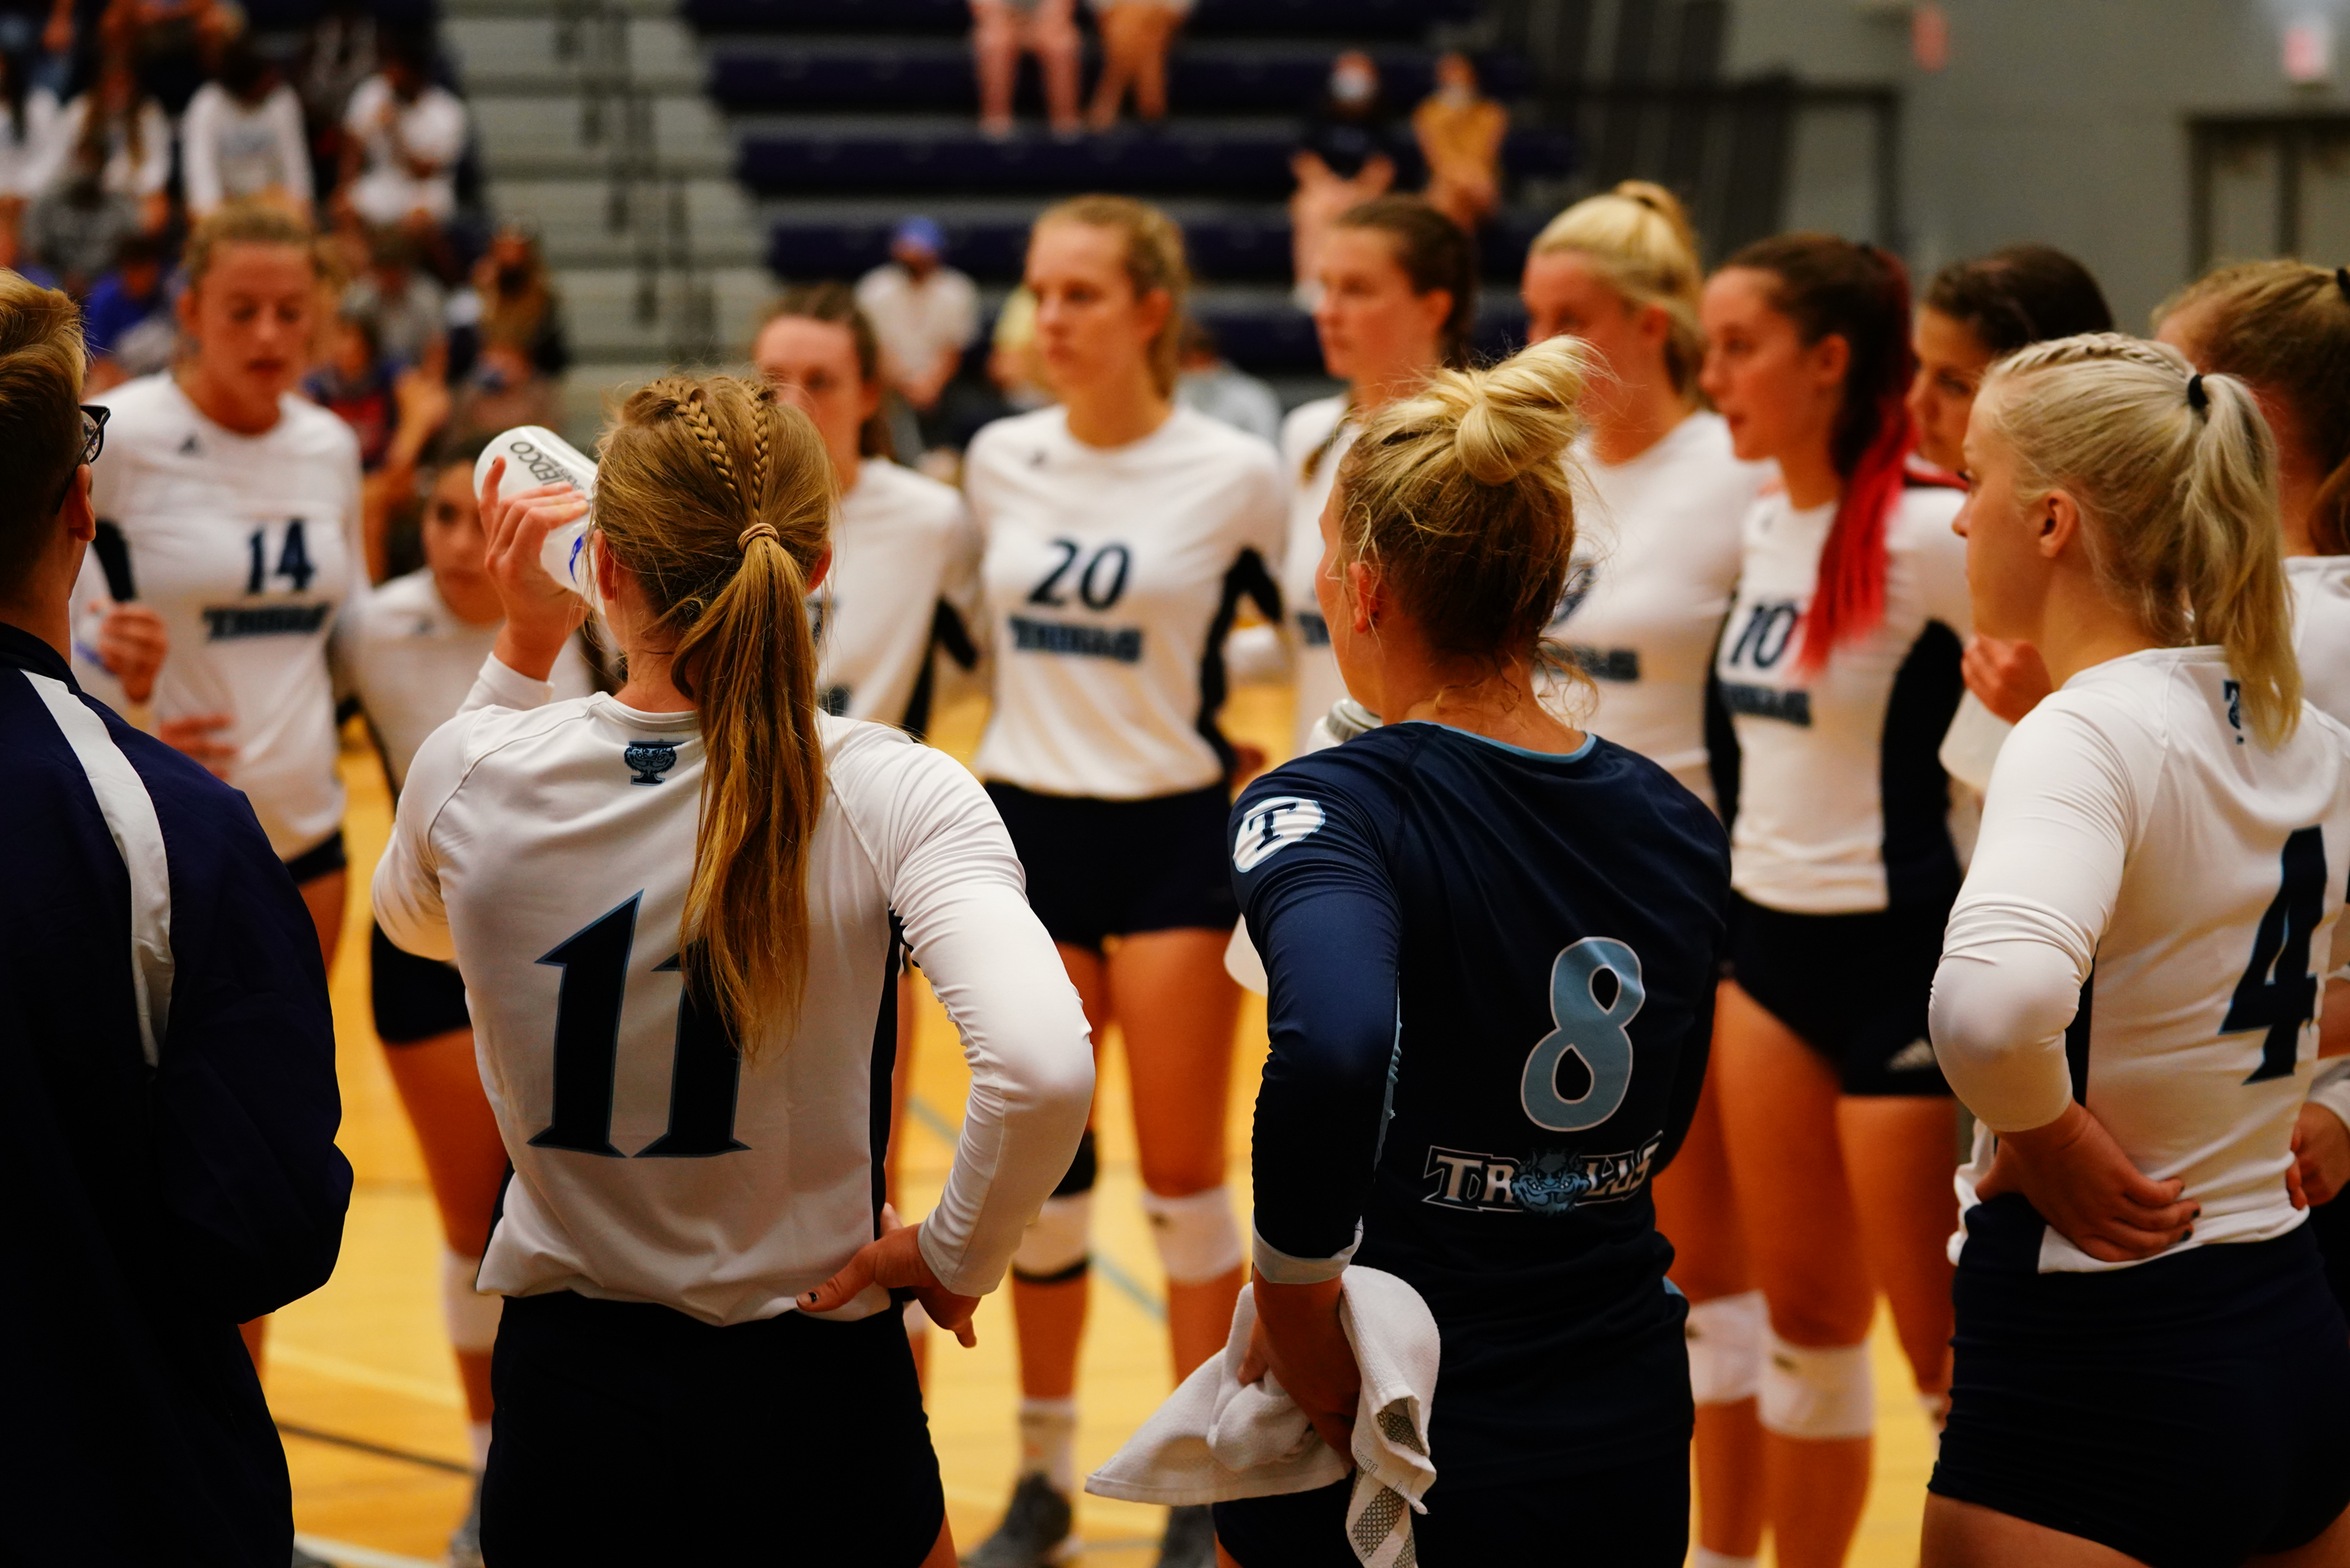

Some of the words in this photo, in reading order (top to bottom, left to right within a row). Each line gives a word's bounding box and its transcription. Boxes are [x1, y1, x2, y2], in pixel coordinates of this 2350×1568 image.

[510, 441, 564, 486] EDCO
[247, 518, 316, 595] 14
[1026, 537, 1130, 611] 20
[1730, 602, 1799, 670] 10
[2218, 824, 2328, 1085] 4
[526, 888, 752, 1158] 11
[1520, 936, 1646, 1132] 8
[1428, 1138, 1662, 1207] TRLLS
